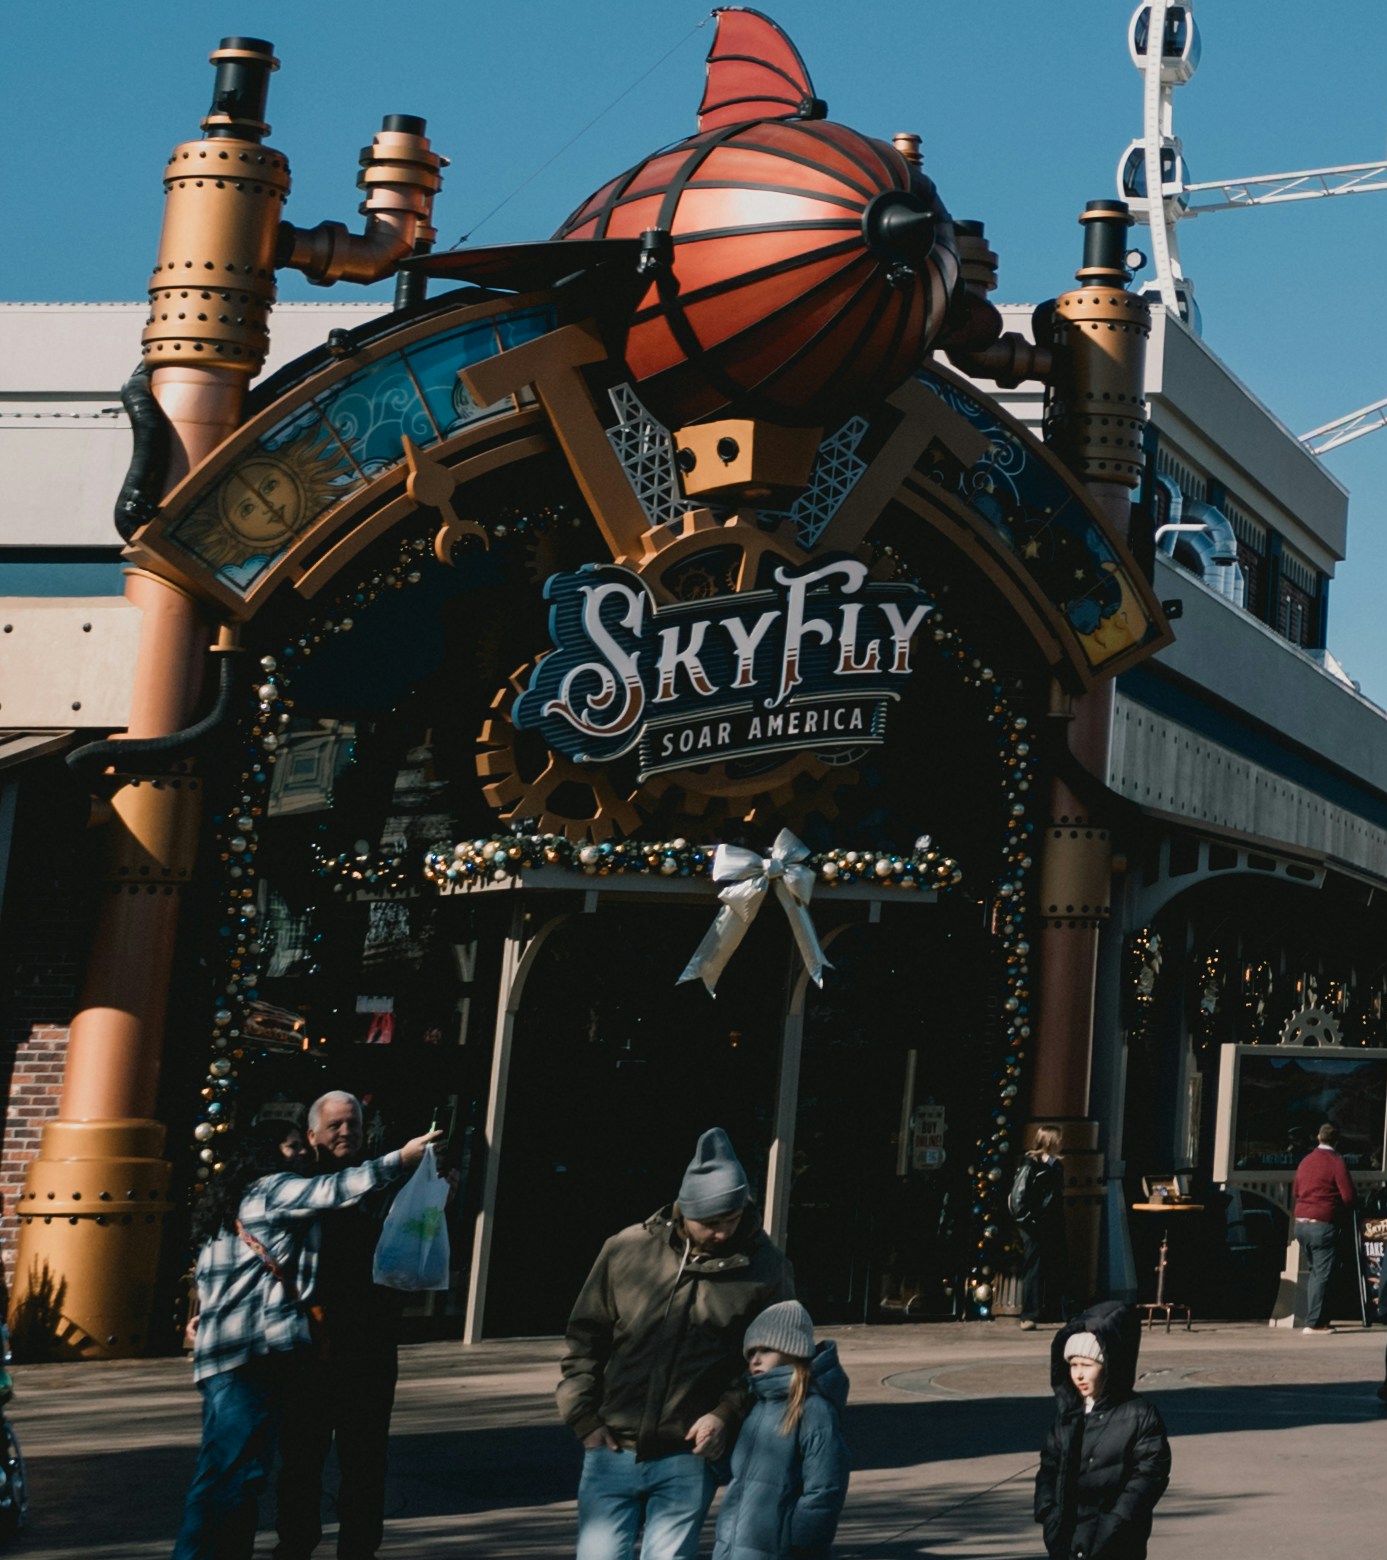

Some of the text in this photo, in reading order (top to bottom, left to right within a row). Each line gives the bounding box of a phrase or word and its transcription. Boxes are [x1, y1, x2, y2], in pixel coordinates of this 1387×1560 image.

[661, 707, 863, 757] SOAR AMERICA
[1364, 1241, 1385, 1257] TAKE
